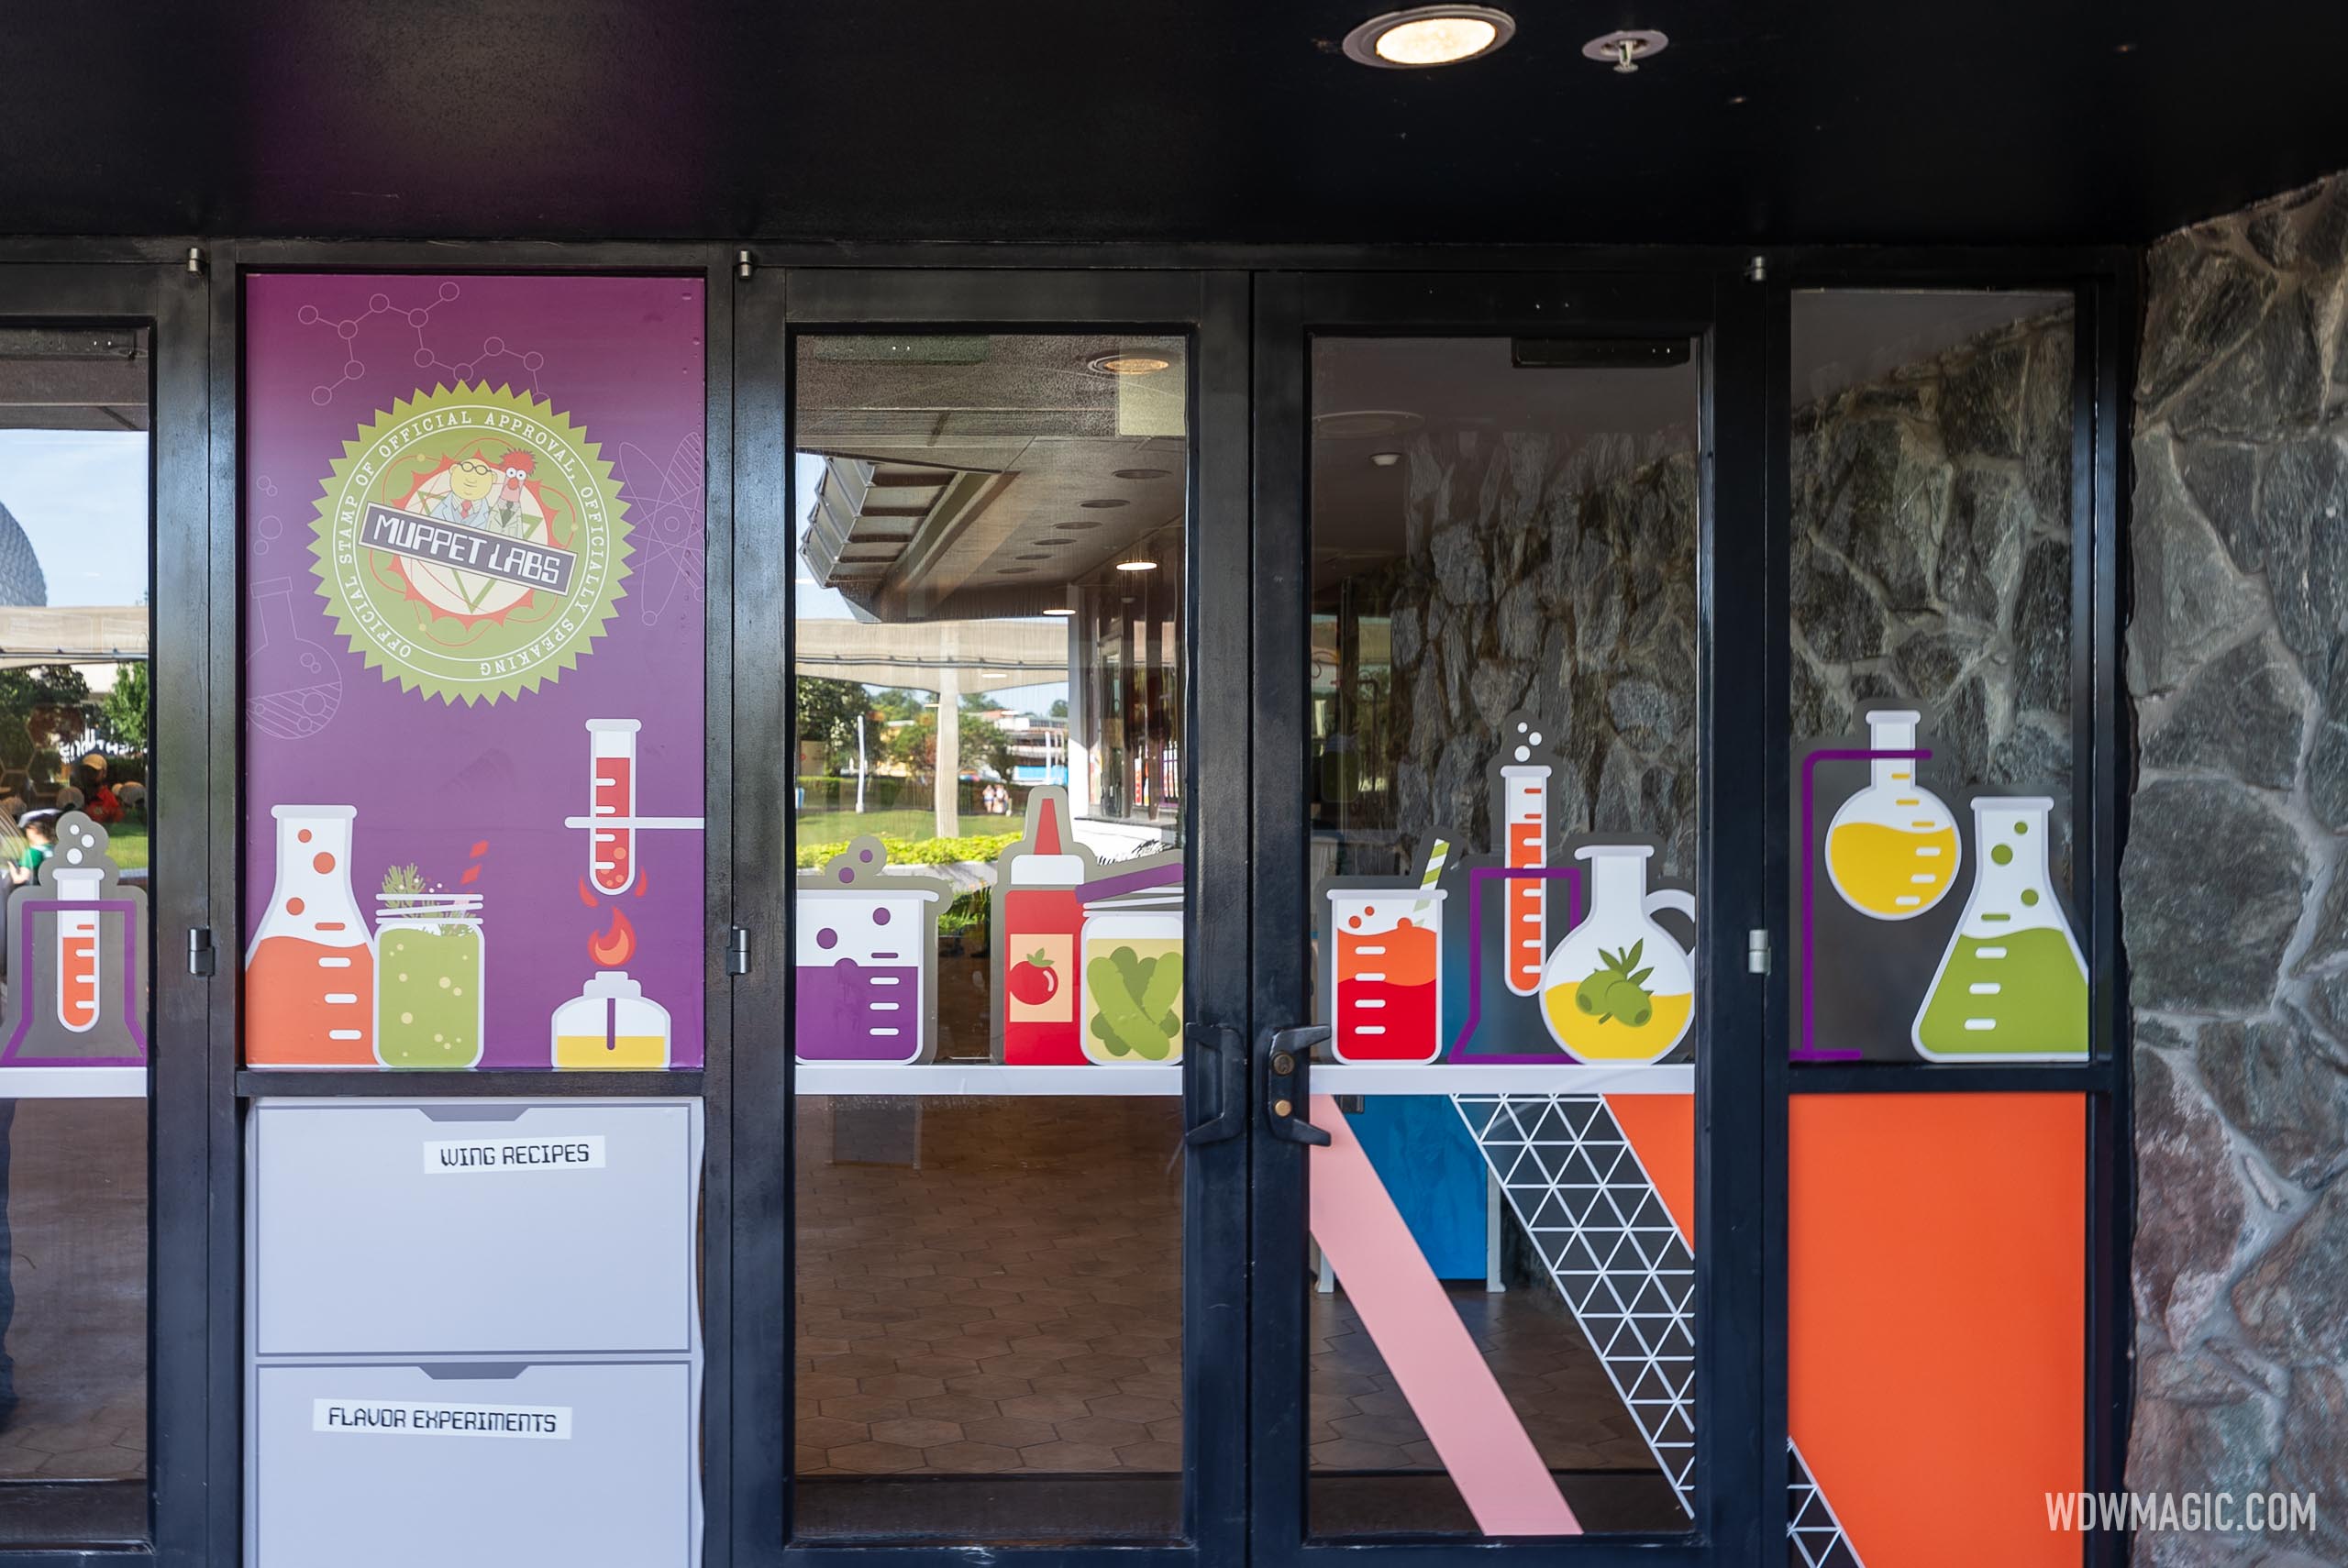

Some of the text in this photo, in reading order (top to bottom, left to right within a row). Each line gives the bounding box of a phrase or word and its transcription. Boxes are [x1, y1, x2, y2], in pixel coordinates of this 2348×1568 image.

[338, 411, 604, 676] OFFICIAL STAMP OF OFFICIAL APPROVAL, OFFICIALLY SPEAKING
[373, 514, 561, 584] MUPPET LABS
[440, 1143, 589, 1166] WING RECIPES
[328, 1408, 557, 1432] FLAVOR EXPERIMENTS
